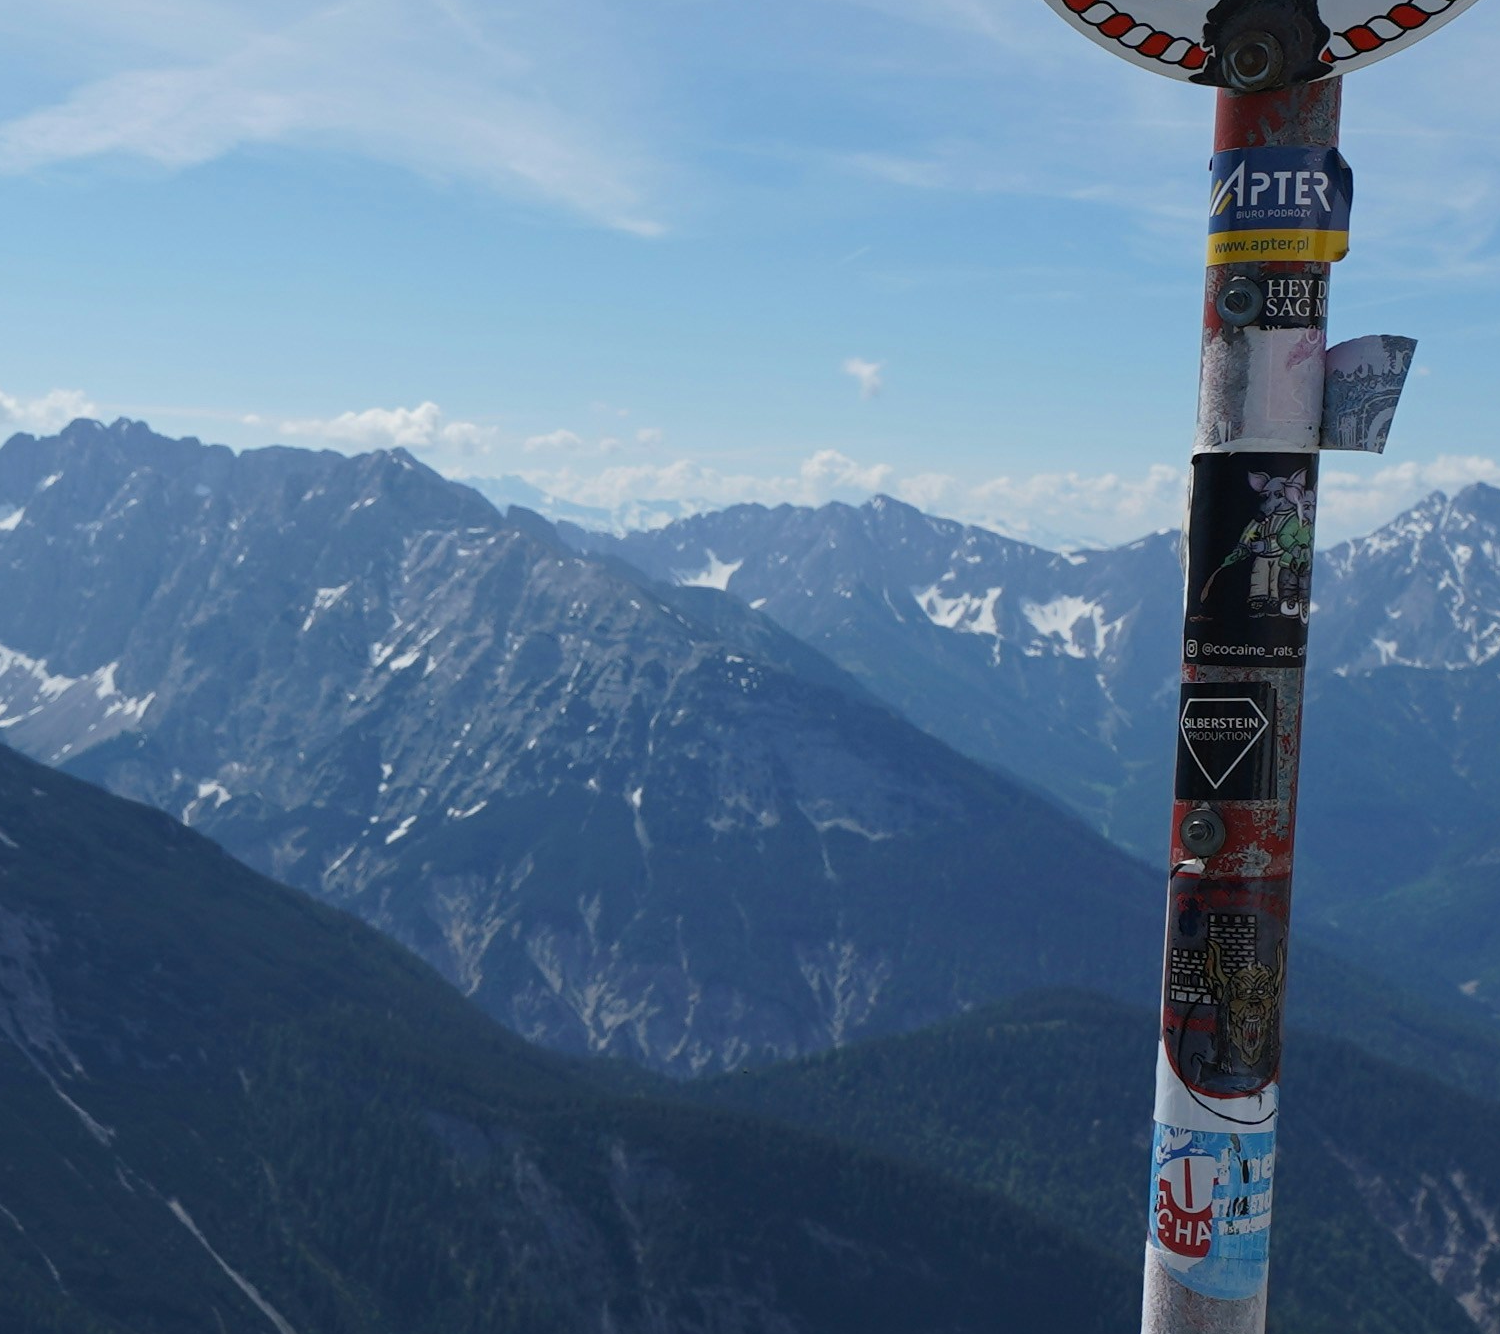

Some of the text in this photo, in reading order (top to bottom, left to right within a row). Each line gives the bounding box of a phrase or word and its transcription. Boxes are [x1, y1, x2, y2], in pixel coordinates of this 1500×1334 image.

[1236, 209, 1265, 220] BIURO
[1215, 236, 1309, 254] www.apter.pl
[1266, 279, 1314, 298] HEY
[1266, 298, 1311, 317] SAG
[1184, 717, 1259, 729] SILBERSTEIN
[1188, 731, 1252, 741] PRODUKTION
